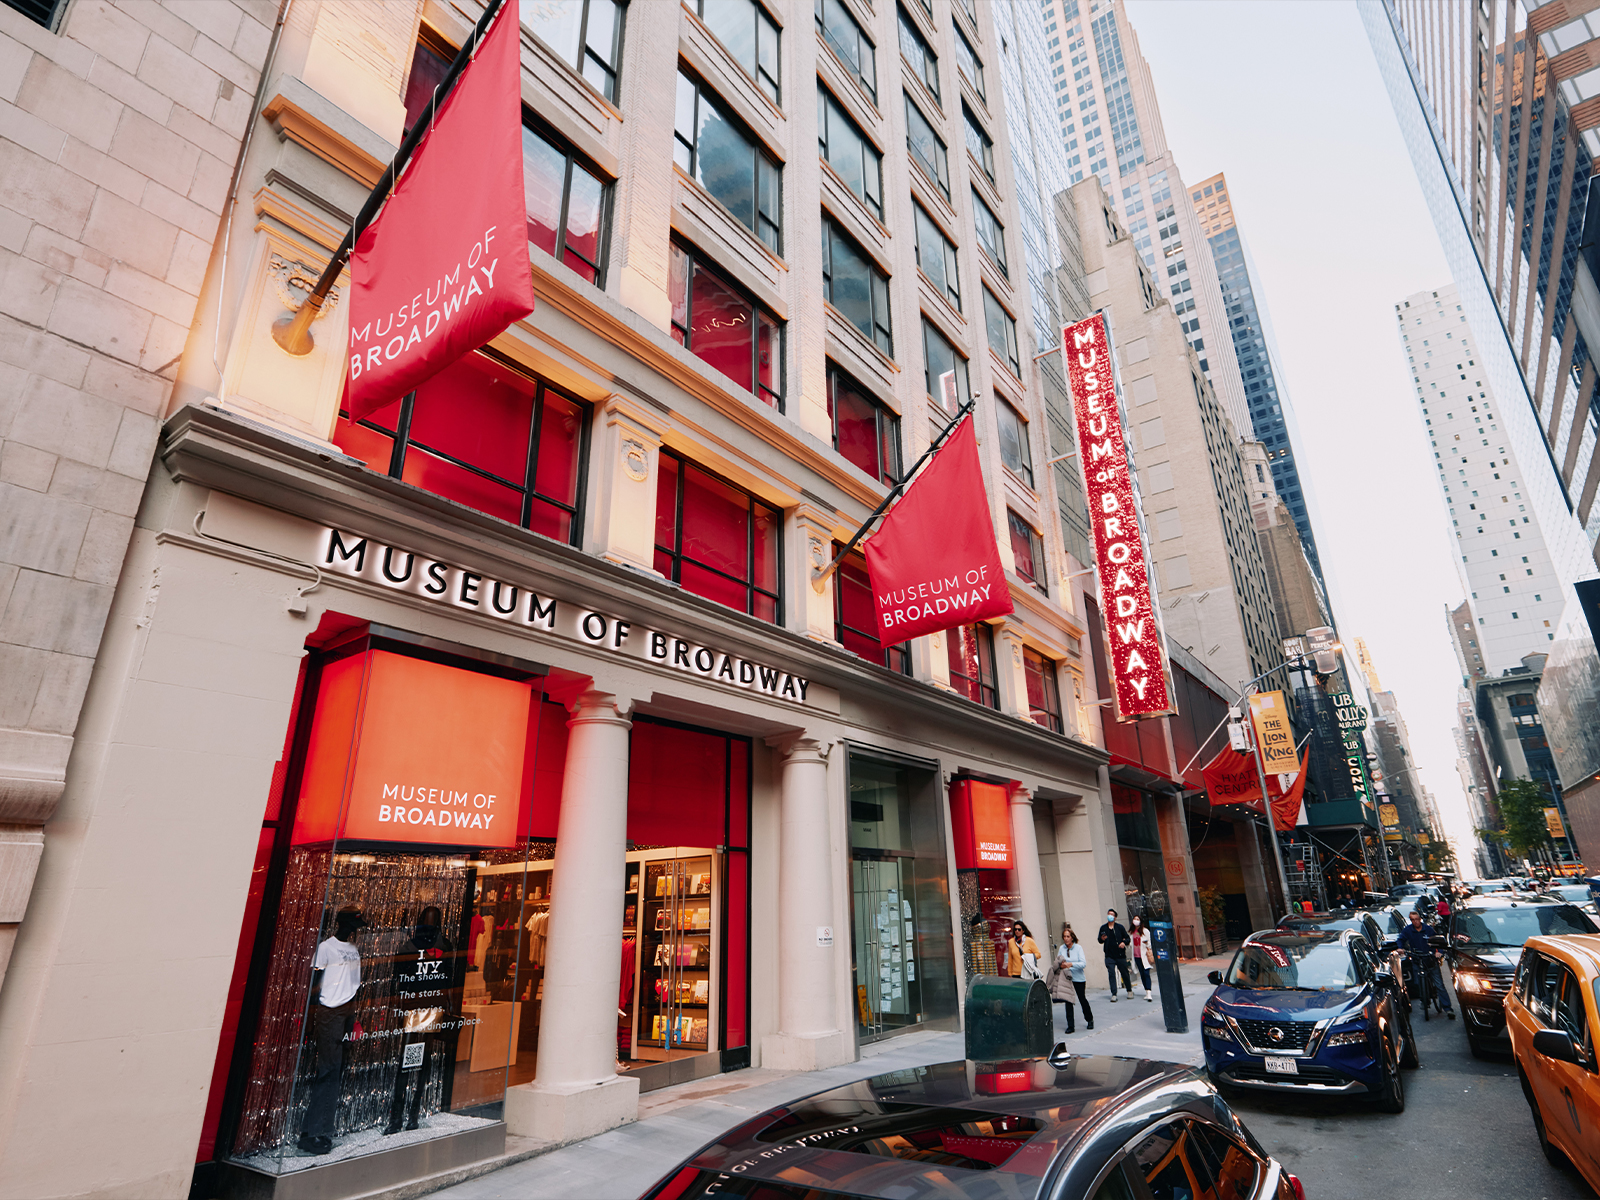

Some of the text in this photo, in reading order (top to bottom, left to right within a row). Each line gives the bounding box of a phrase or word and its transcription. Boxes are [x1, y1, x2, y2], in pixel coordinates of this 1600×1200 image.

[351, 226, 497, 348] MUSEUM OF
[351, 258, 499, 381] BROADWAY
[1074, 326, 1113, 461] MUSEUM
[1101, 492, 1148, 700] BROADWAY
[879, 565, 987, 609] MUSEUM OF
[882, 583, 992, 628] BROADWAY
[326, 529, 811, 701] MUSEUM OF BROADWAY
[1329, 694, 1353, 707] UB
[1335, 705, 1367, 722] NOLLY'S
[1263, 720, 1281, 729] THE
[1262, 732, 1287, 745] LION
[1263, 746, 1294, 761] KING
[1221, 768, 1259, 782] HYATT
[383, 783, 497, 809] MUSEUM OF
[378, 805, 494, 829] BROADWAY
[980, 842, 1000, 851] MUSEUM
[980, 851, 1007, 861] BROADWAY
[418, 949, 425, 960] I
[415, 961, 443, 975] NY
[399, 973, 448, 982] The shows.
[400, 990, 444, 1000] The stars.
[393, 1008, 409, 1017] The
[342, 1032, 356, 1042] All
[359, 1030, 368, 1039] in
[372, 1029, 390, 1038] one
[457, 1018, 484, 1029] place.
